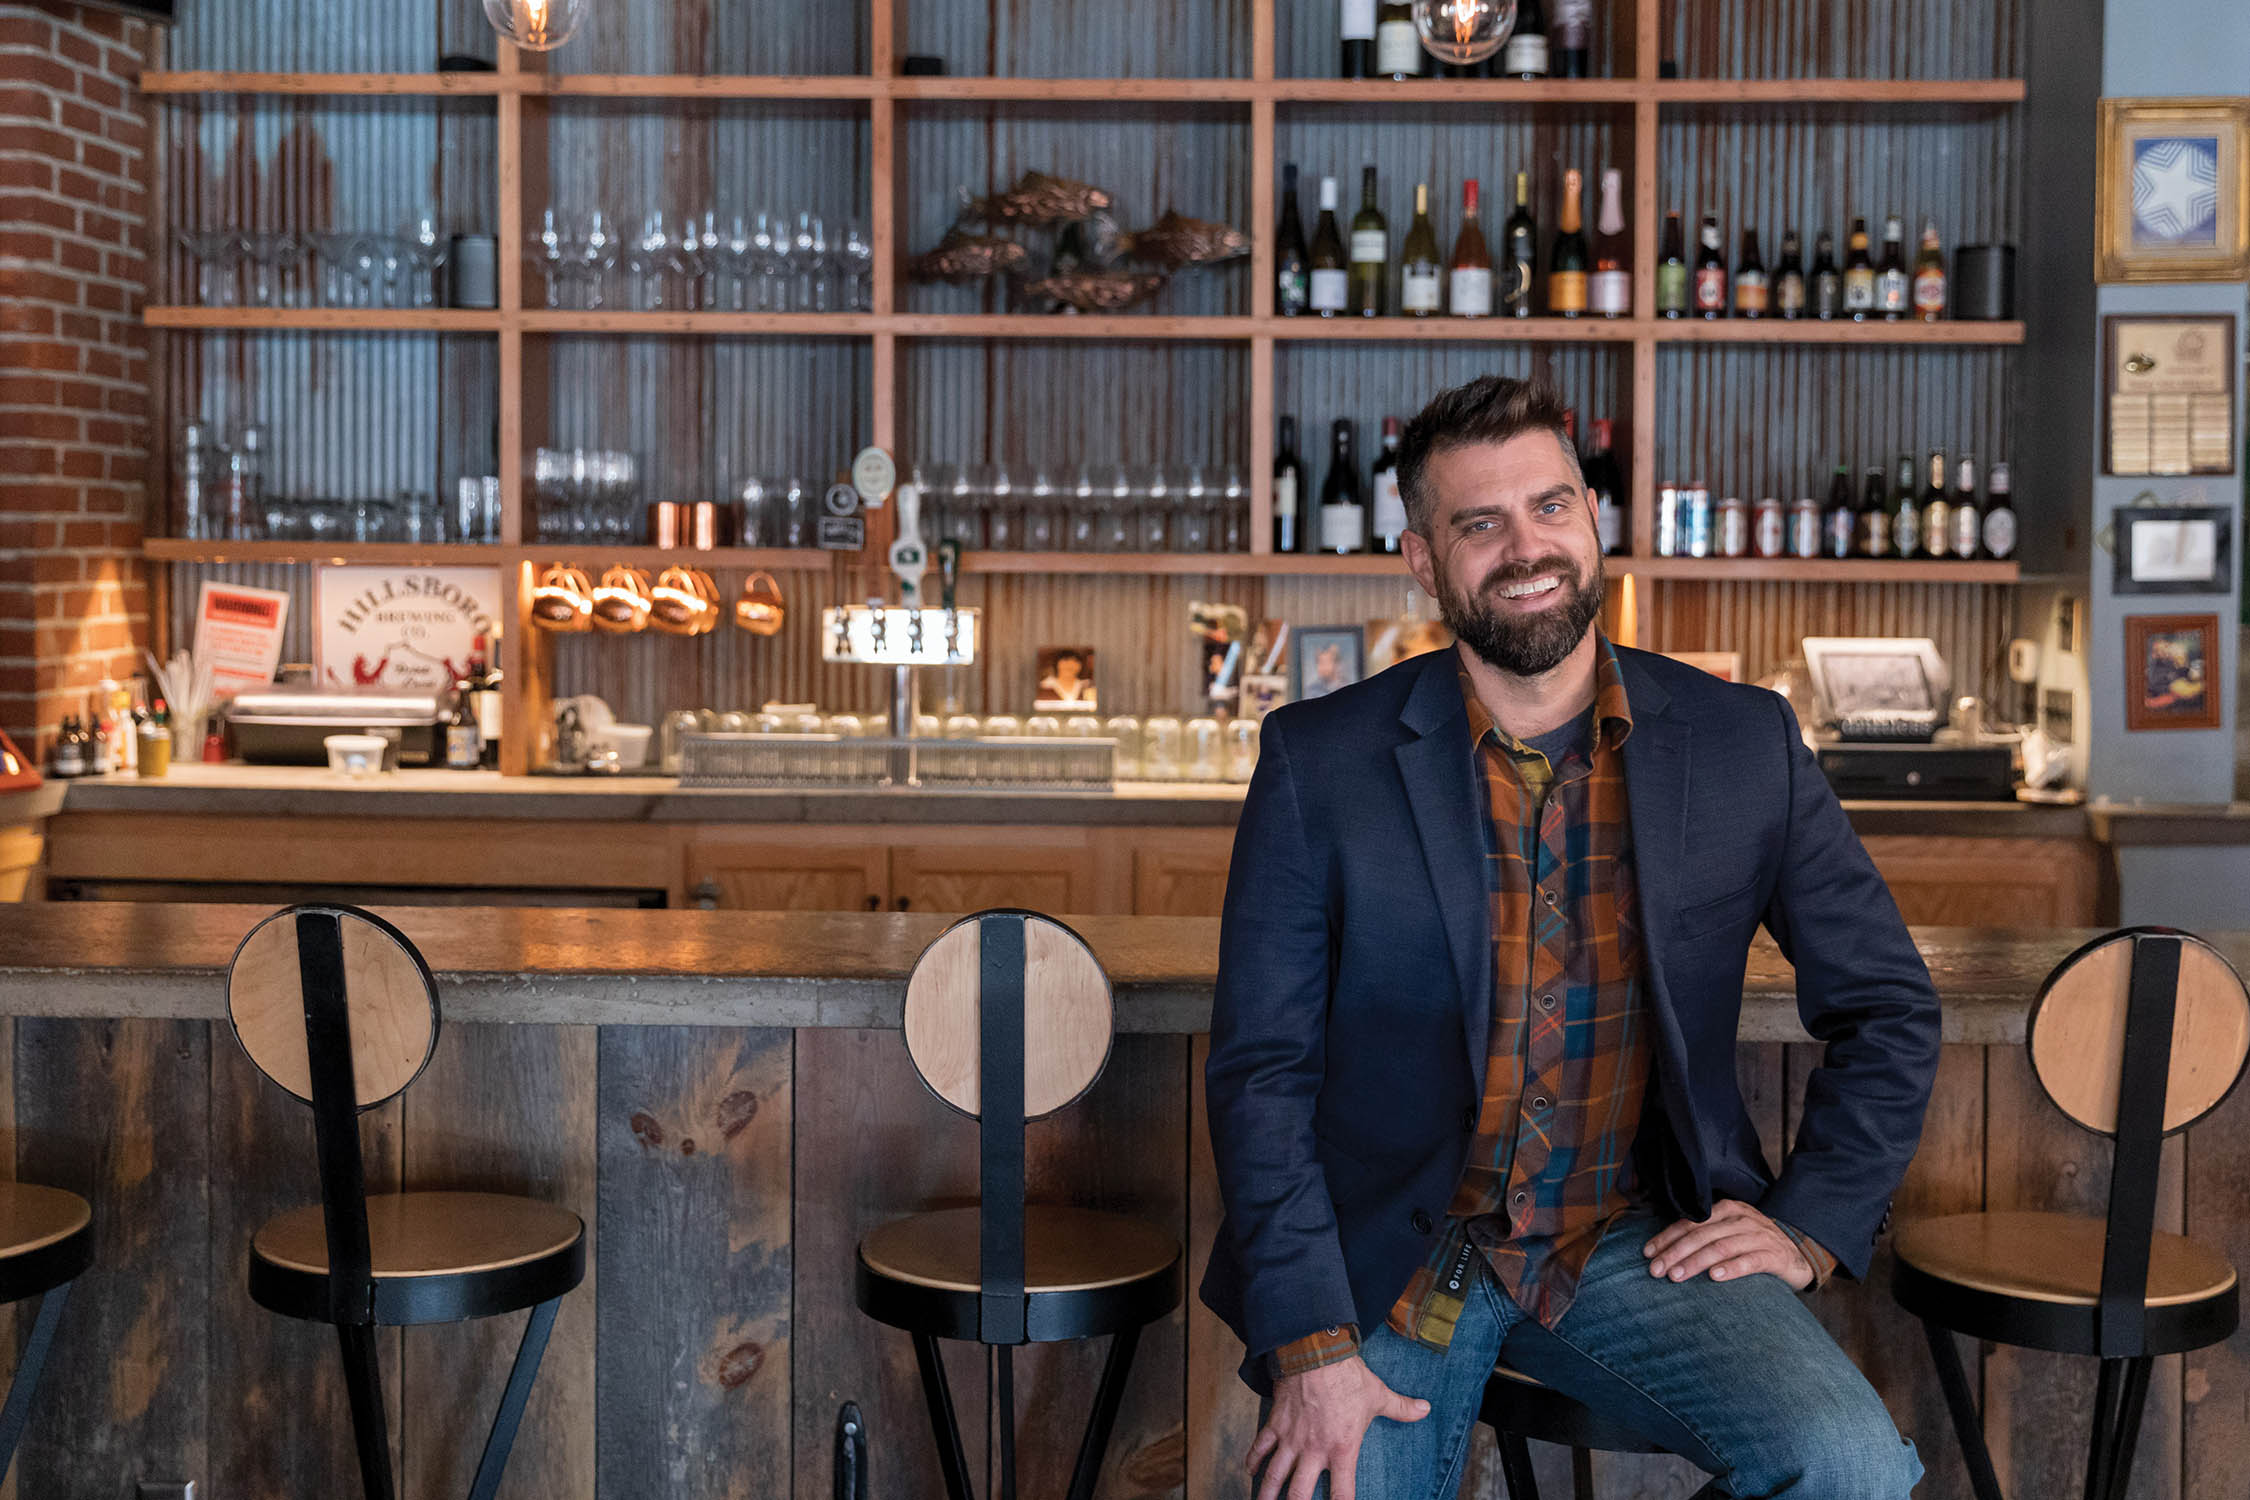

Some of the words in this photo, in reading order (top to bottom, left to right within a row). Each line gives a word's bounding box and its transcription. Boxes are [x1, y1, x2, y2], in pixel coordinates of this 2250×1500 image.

[338, 574, 493, 635] HILLSBORO
[376, 610, 457, 624] BREWING
[1453, 1263, 1465, 1280] FOR
[1460, 1243, 1472, 1261] LIFE
